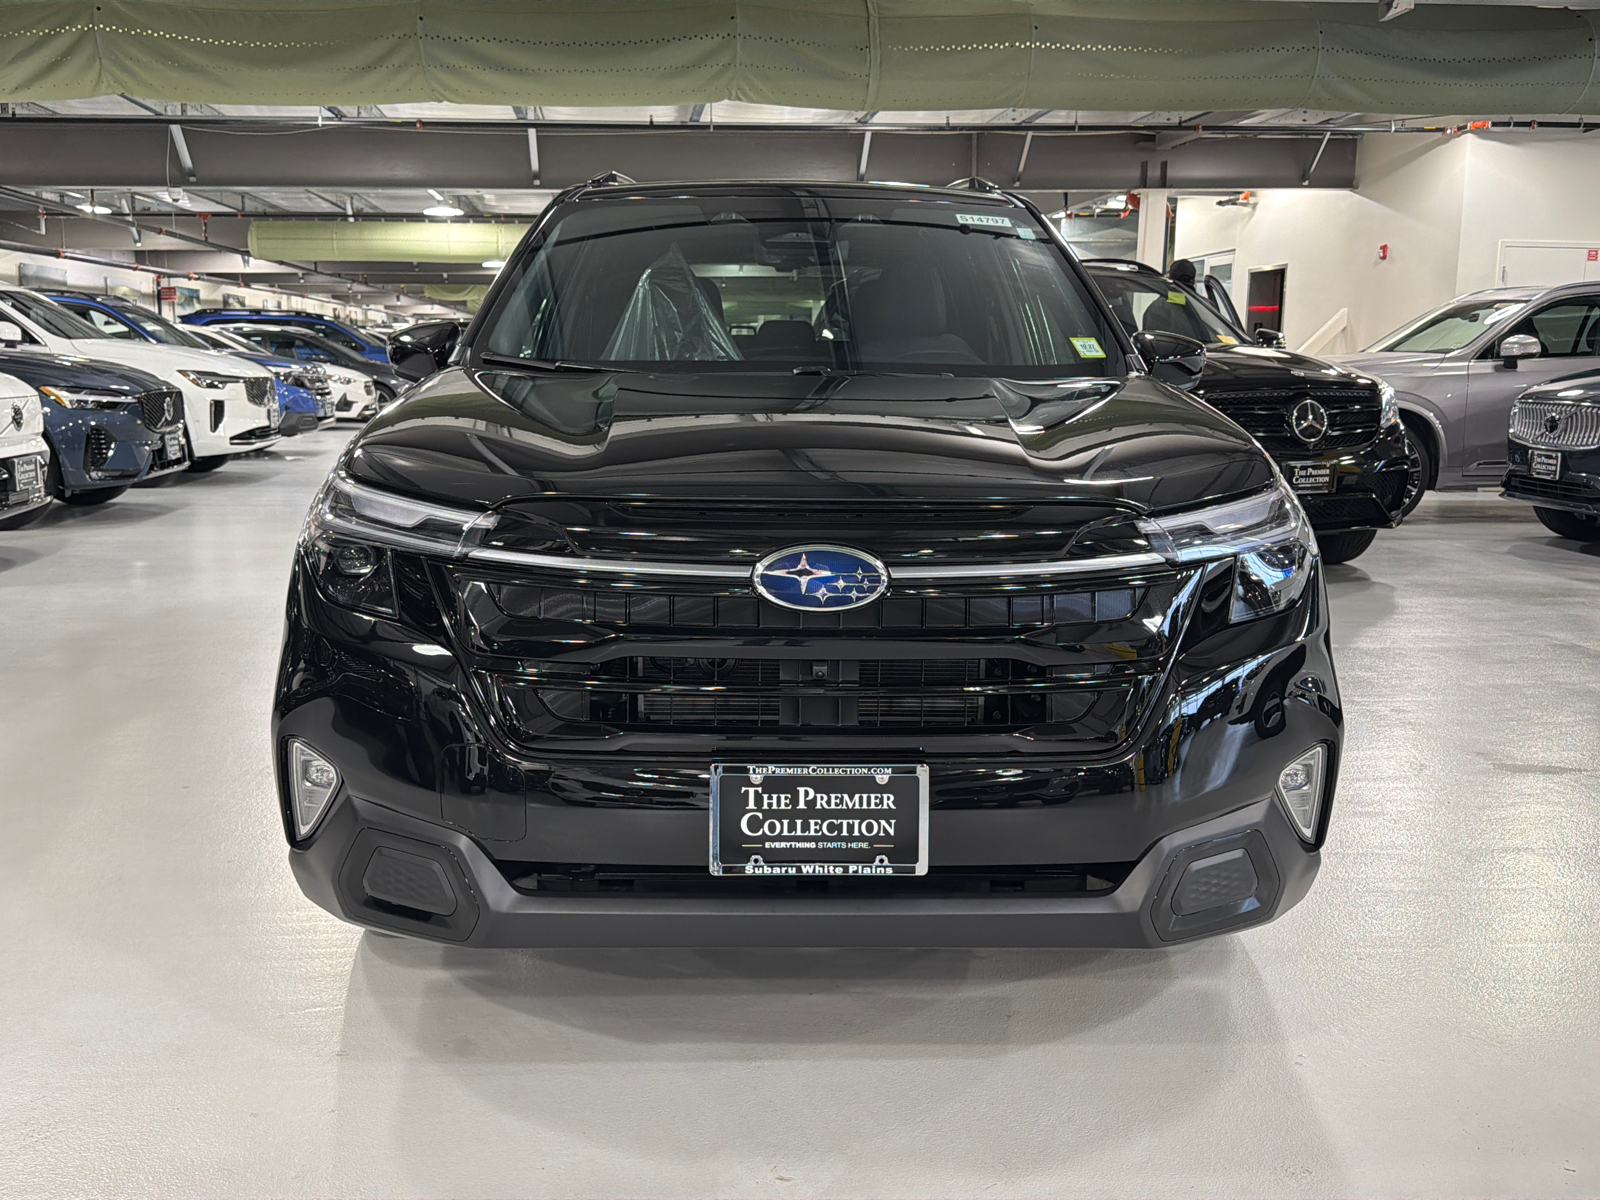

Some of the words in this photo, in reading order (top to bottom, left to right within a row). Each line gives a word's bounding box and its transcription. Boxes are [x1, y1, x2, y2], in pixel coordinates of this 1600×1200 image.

[959, 215, 1006, 225] S14797
[1293, 476, 1329, 484] COLLECTION
[741, 786, 792, 810] THE
[796, 786, 896, 810] PREMIER
[740, 812, 896, 836] COLLECTION
[745, 865, 797, 874] Subaru
[801, 865, 842, 874] White
[848, 865, 893, 874] Plains
